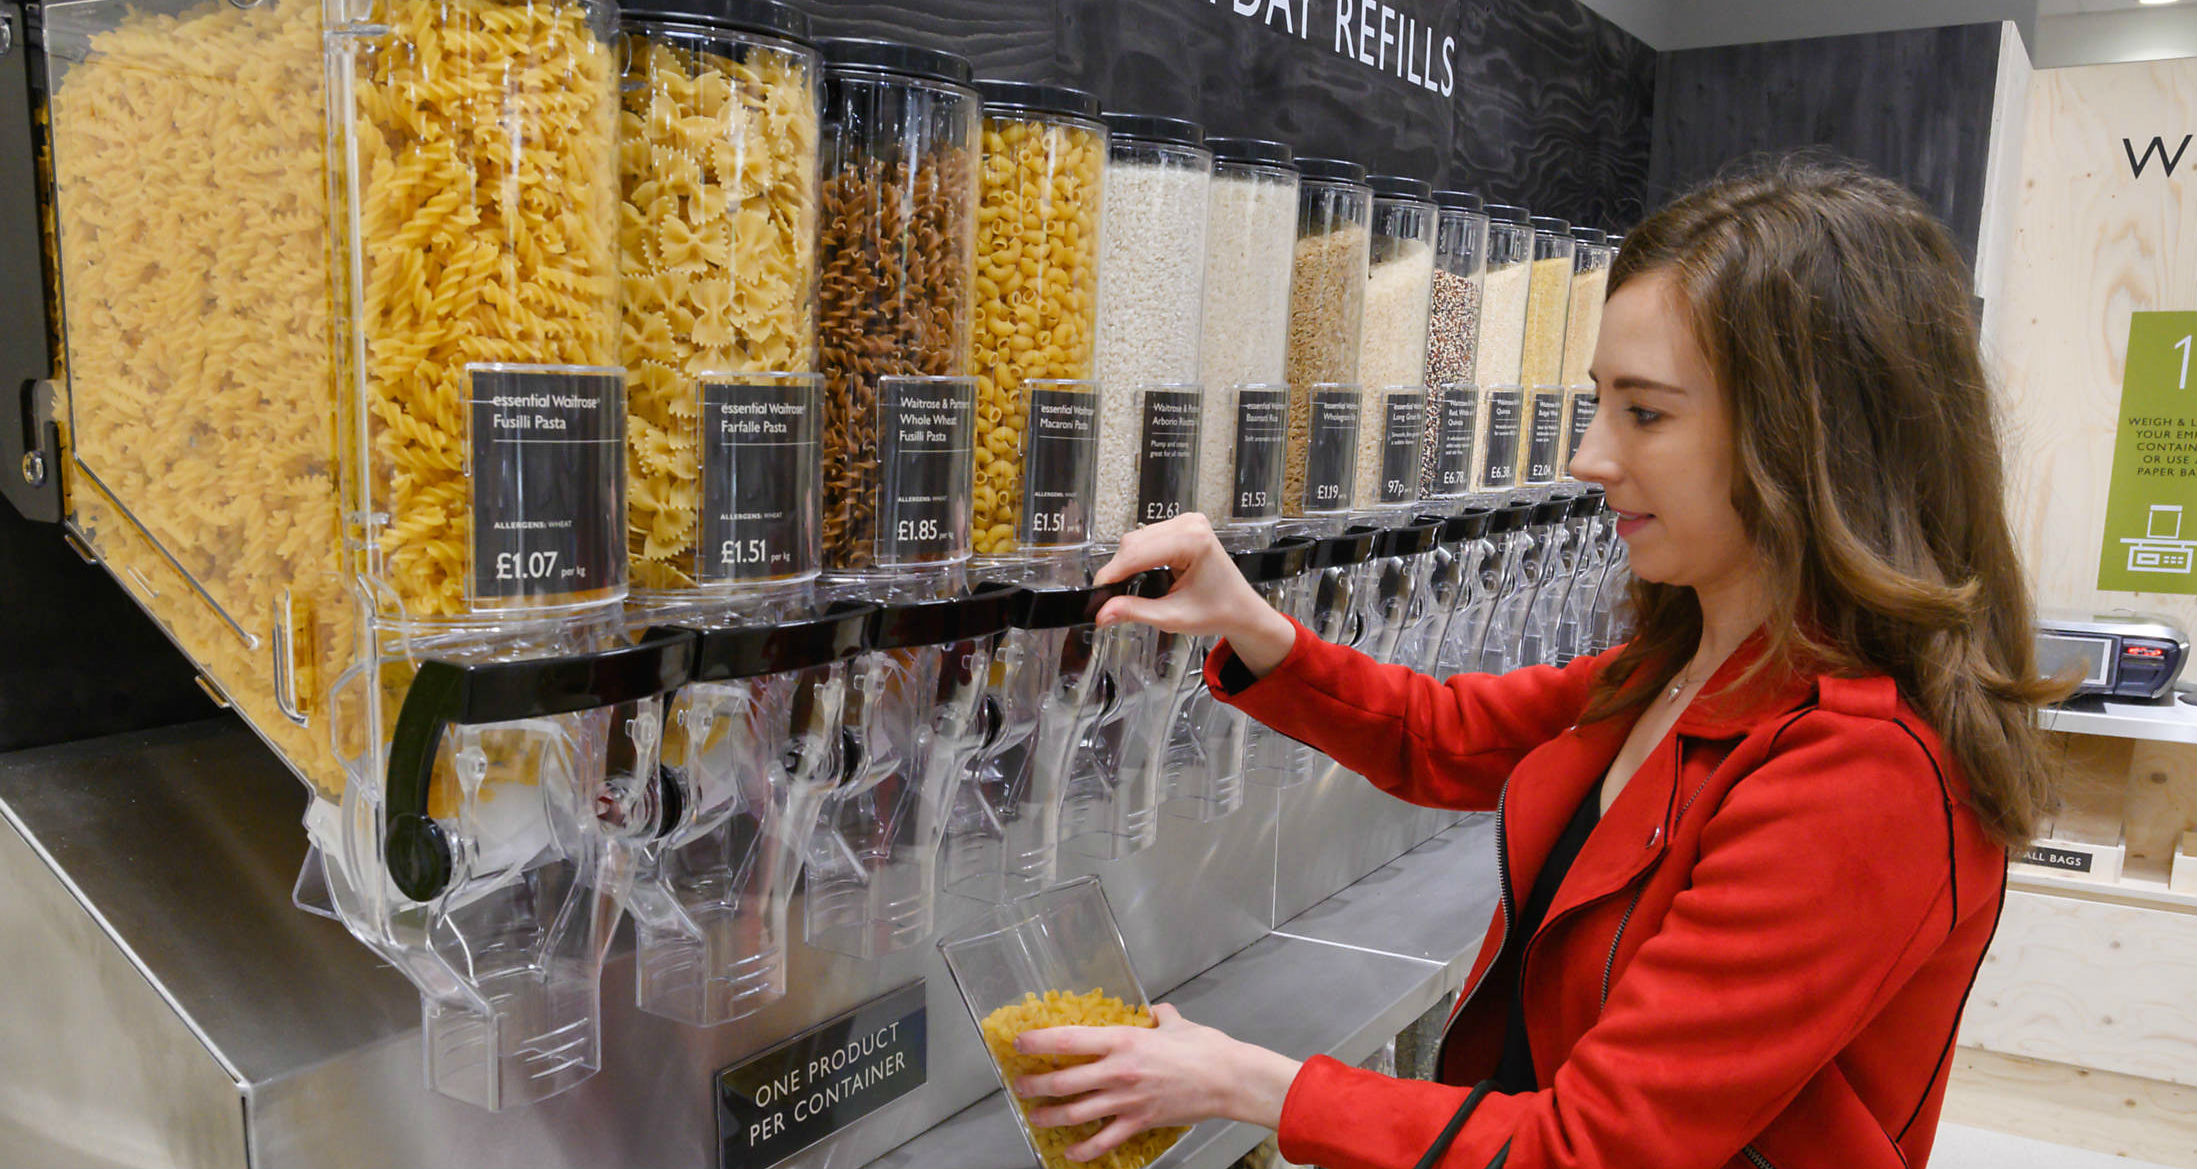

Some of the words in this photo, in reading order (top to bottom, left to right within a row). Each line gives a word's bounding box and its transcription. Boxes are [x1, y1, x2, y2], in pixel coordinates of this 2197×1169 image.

[1335, 0, 1455, 97] REFILLS
[2174, 334, 2192, 390] 1
[493, 394, 549, 408] essential
[900, 396, 940, 409] Waitrose
[942, 399, 948, 409] &
[721, 402, 767, 415] essential
[1041, 404, 1072, 415] essential
[493, 413, 531, 429] Fusilli
[535, 414, 566, 430] Pasta
[721, 419, 760, 433] Farfalle
[763, 420, 787, 434] Pasta
[900, 413, 931, 426] Whole
[932, 414, 957, 426] Wheat
[1040, 418, 1073, 430] Macaroni
[1152, 416, 1178, 426] Arborio
[2128, 417, 2172, 427] WEIGH
[2178, 418, 2185, 427] &
[900, 430, 924, 442] Fusilli
[926, 430, 947, 442] Pasta
[2136, 430, 2171, 439] YOUR
[2143, 455, 2161, 464] OR
[2167, 455, 2190, 465] USE
[2137, 467, 2174, 477] PAPER
[1388, 479, 1405, 497] 97p
[1241, 491, 1266, 508] £1.53
[1146, 502, 1180, 519] £2.63
[549, 520, 572, 528] WHEAT
[1033, 512, 1065, 532] £1.51
[898, 519, 938, 541] £1.85
[721, 539, 766, 563] £1.51
[771, 554, 781, 564] per
[782, 551, 791, 562] kg
[496, 551, 558, 579] £1.07
[561, 568, 575, 579] per
[576, 565, 586, 578] kg
[2049, 853, 2082, 867] BAGS
[755, 1069, 800, 1108] ONE
[809, 1021, 900, 1084] PRODUCT
[750, 1111, 786, 1147] PER
[794, 1051, 906, 1123] CONTAINER
